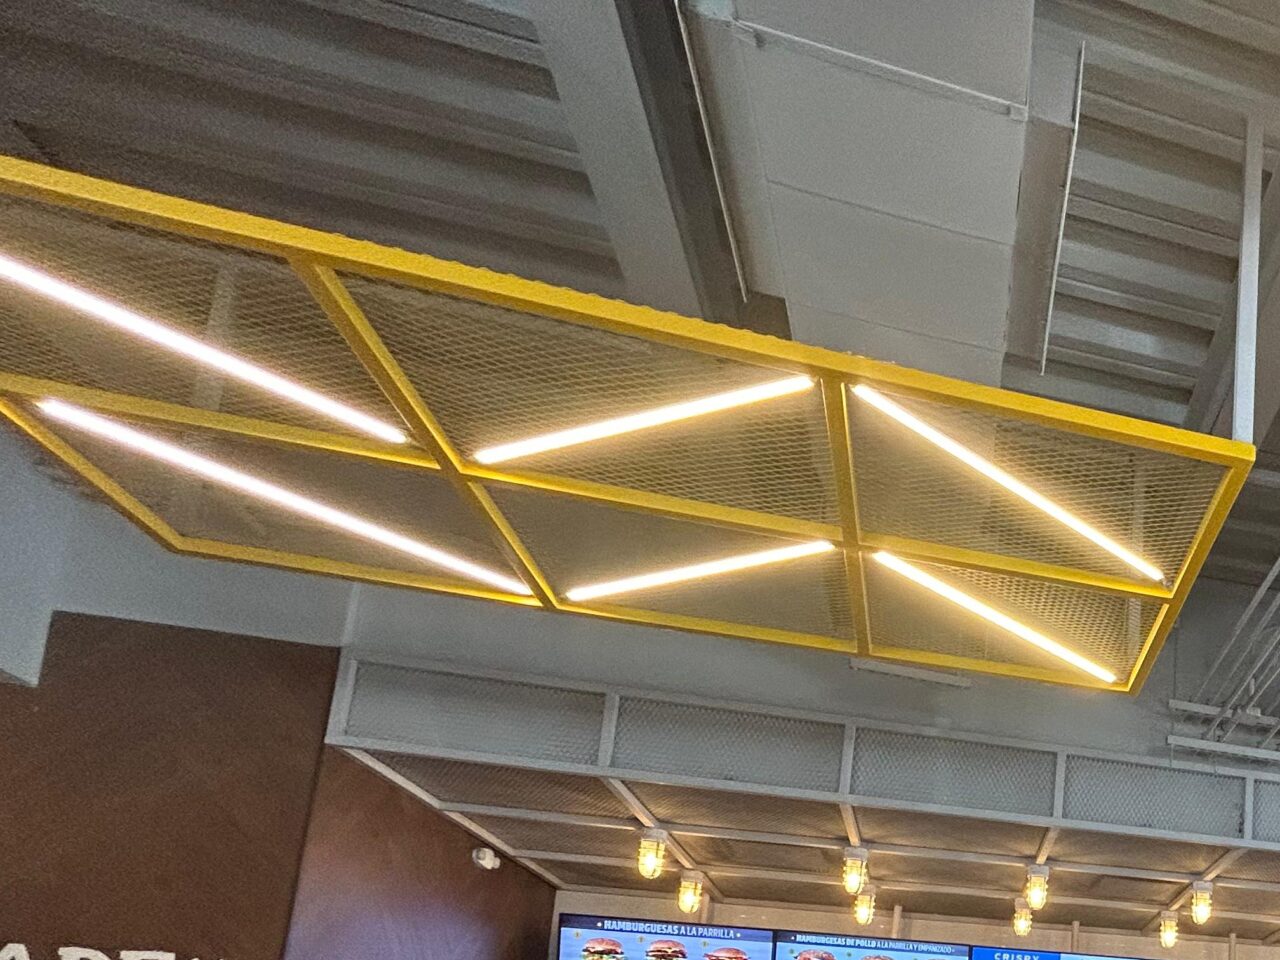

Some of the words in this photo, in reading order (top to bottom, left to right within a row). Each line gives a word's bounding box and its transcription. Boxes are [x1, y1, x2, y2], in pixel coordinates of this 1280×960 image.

[603, 920, 679, 935] HAMBURGUESAS
[698, 927, 735, 939] PARRILLA
[856, 939, 876, 948] POLLO
